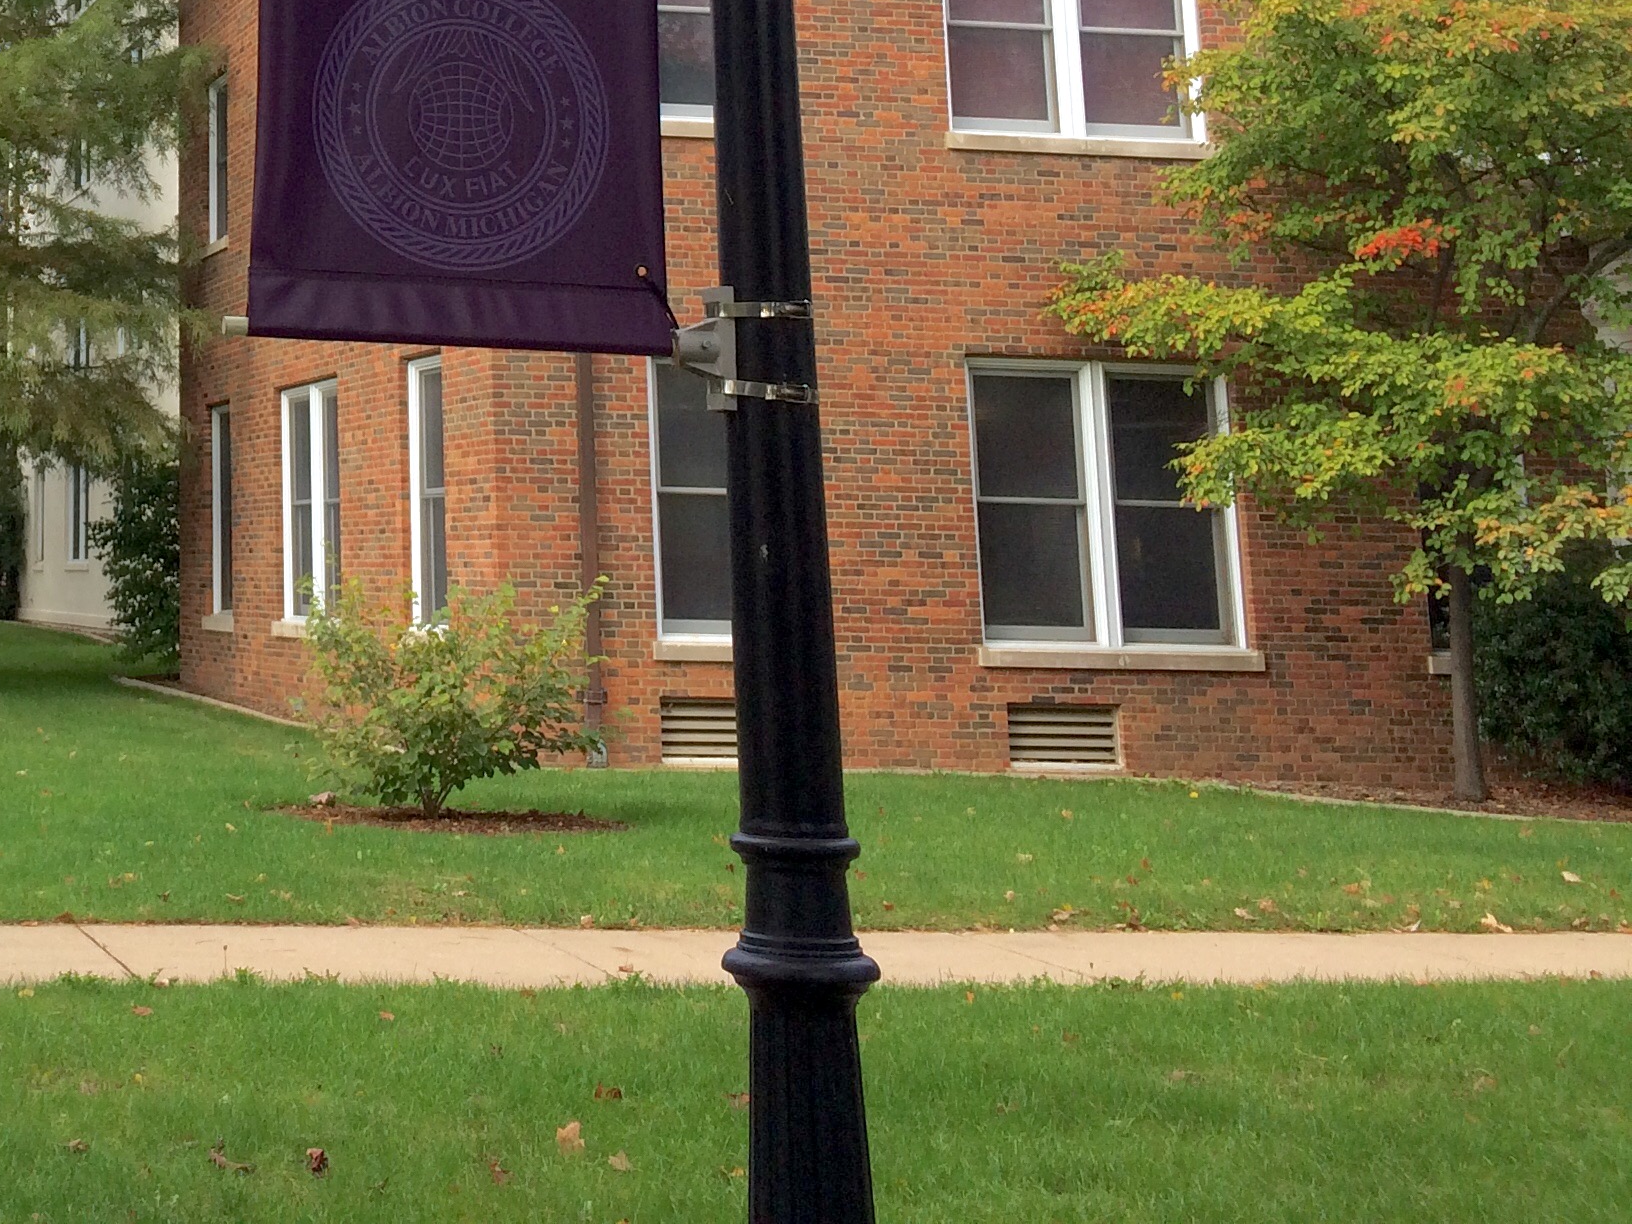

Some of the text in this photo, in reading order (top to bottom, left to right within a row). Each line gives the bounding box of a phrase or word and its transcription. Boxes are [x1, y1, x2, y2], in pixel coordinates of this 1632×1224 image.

[355, 154, 569, 237] ALBION MICHIGAN
[402, 156, 518, 198] LUX FIAT
